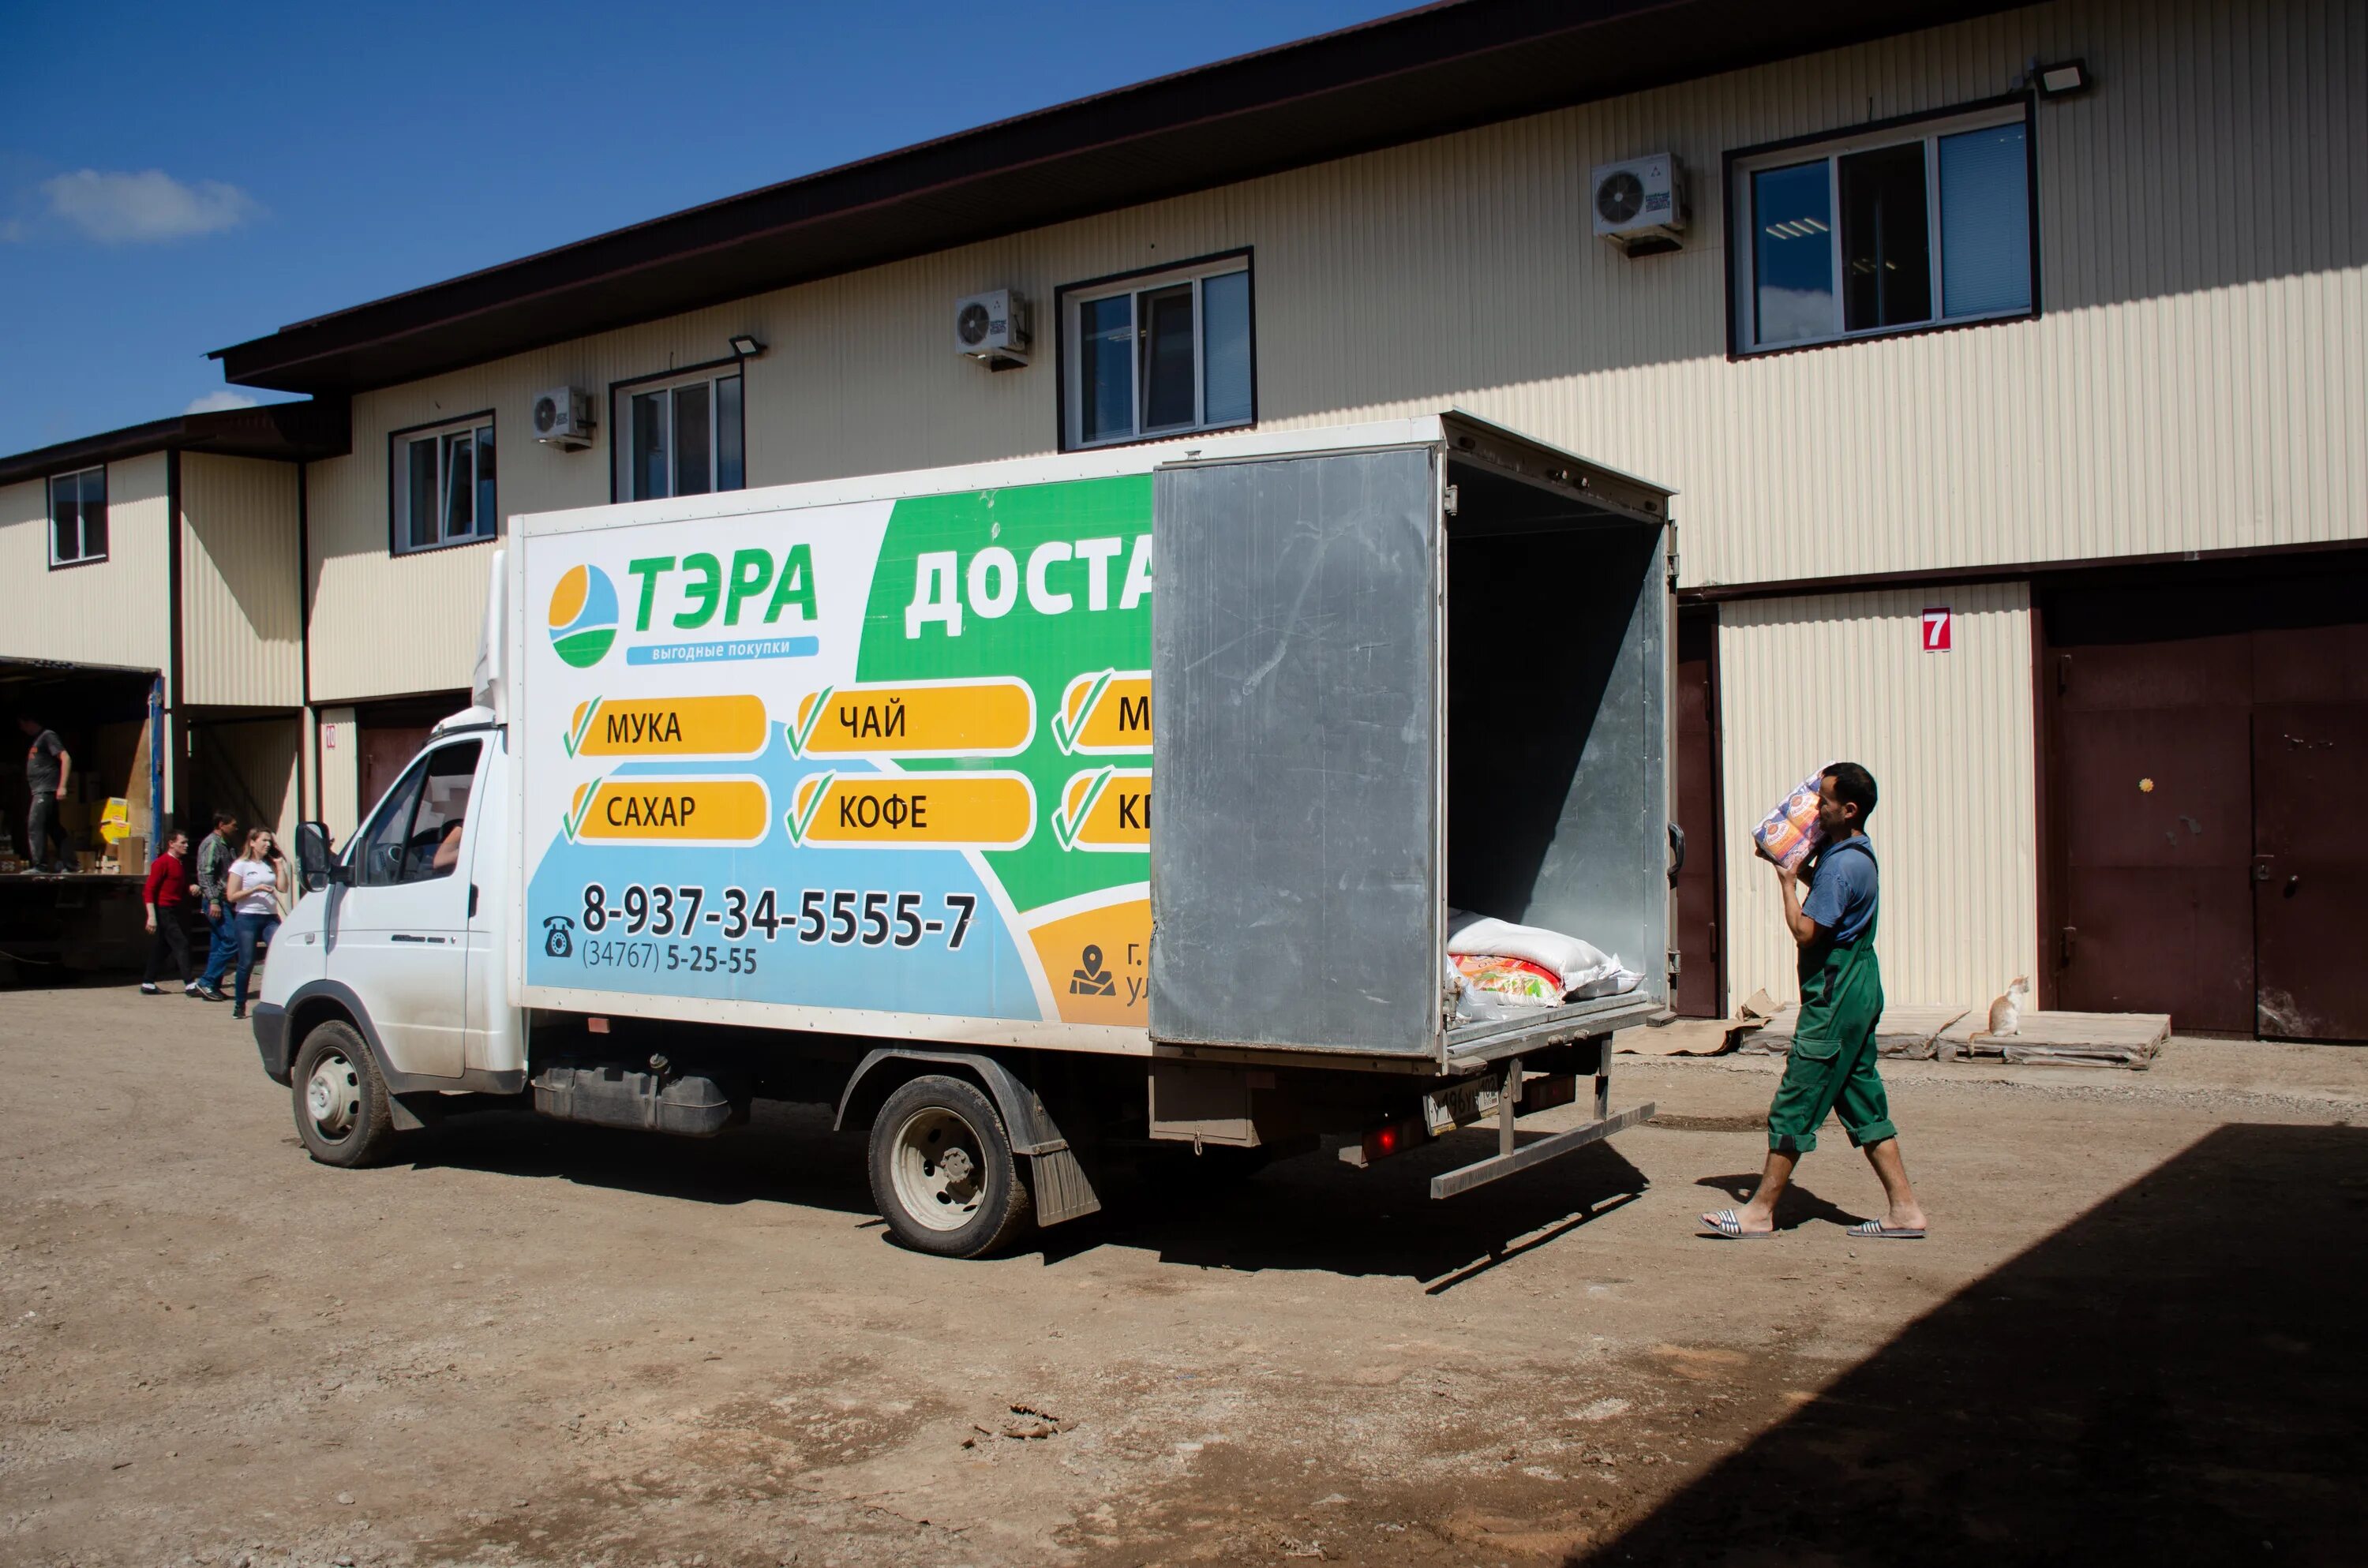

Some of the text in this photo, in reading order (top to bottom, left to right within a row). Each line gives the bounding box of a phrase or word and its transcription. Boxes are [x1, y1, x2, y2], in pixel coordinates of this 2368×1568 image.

[629, 544, 818, 632] ТЭРА
[1924, 612, 1948, 646] 7
[652, 641, 790, 661] выгодные покупки
[607, 712, 682, 743] МУКА
[840, 697, 905, 738] ЧАЙ
[607, 796, 695, 827] САХАР
[840, 793, 927, 829] КОФЕ
[583, 884, 976, 948] 8-937-34-5555-7
[583, 939, 758, 975] (34767) 5-25-55
[1128, 943, 1142, 966] г.
